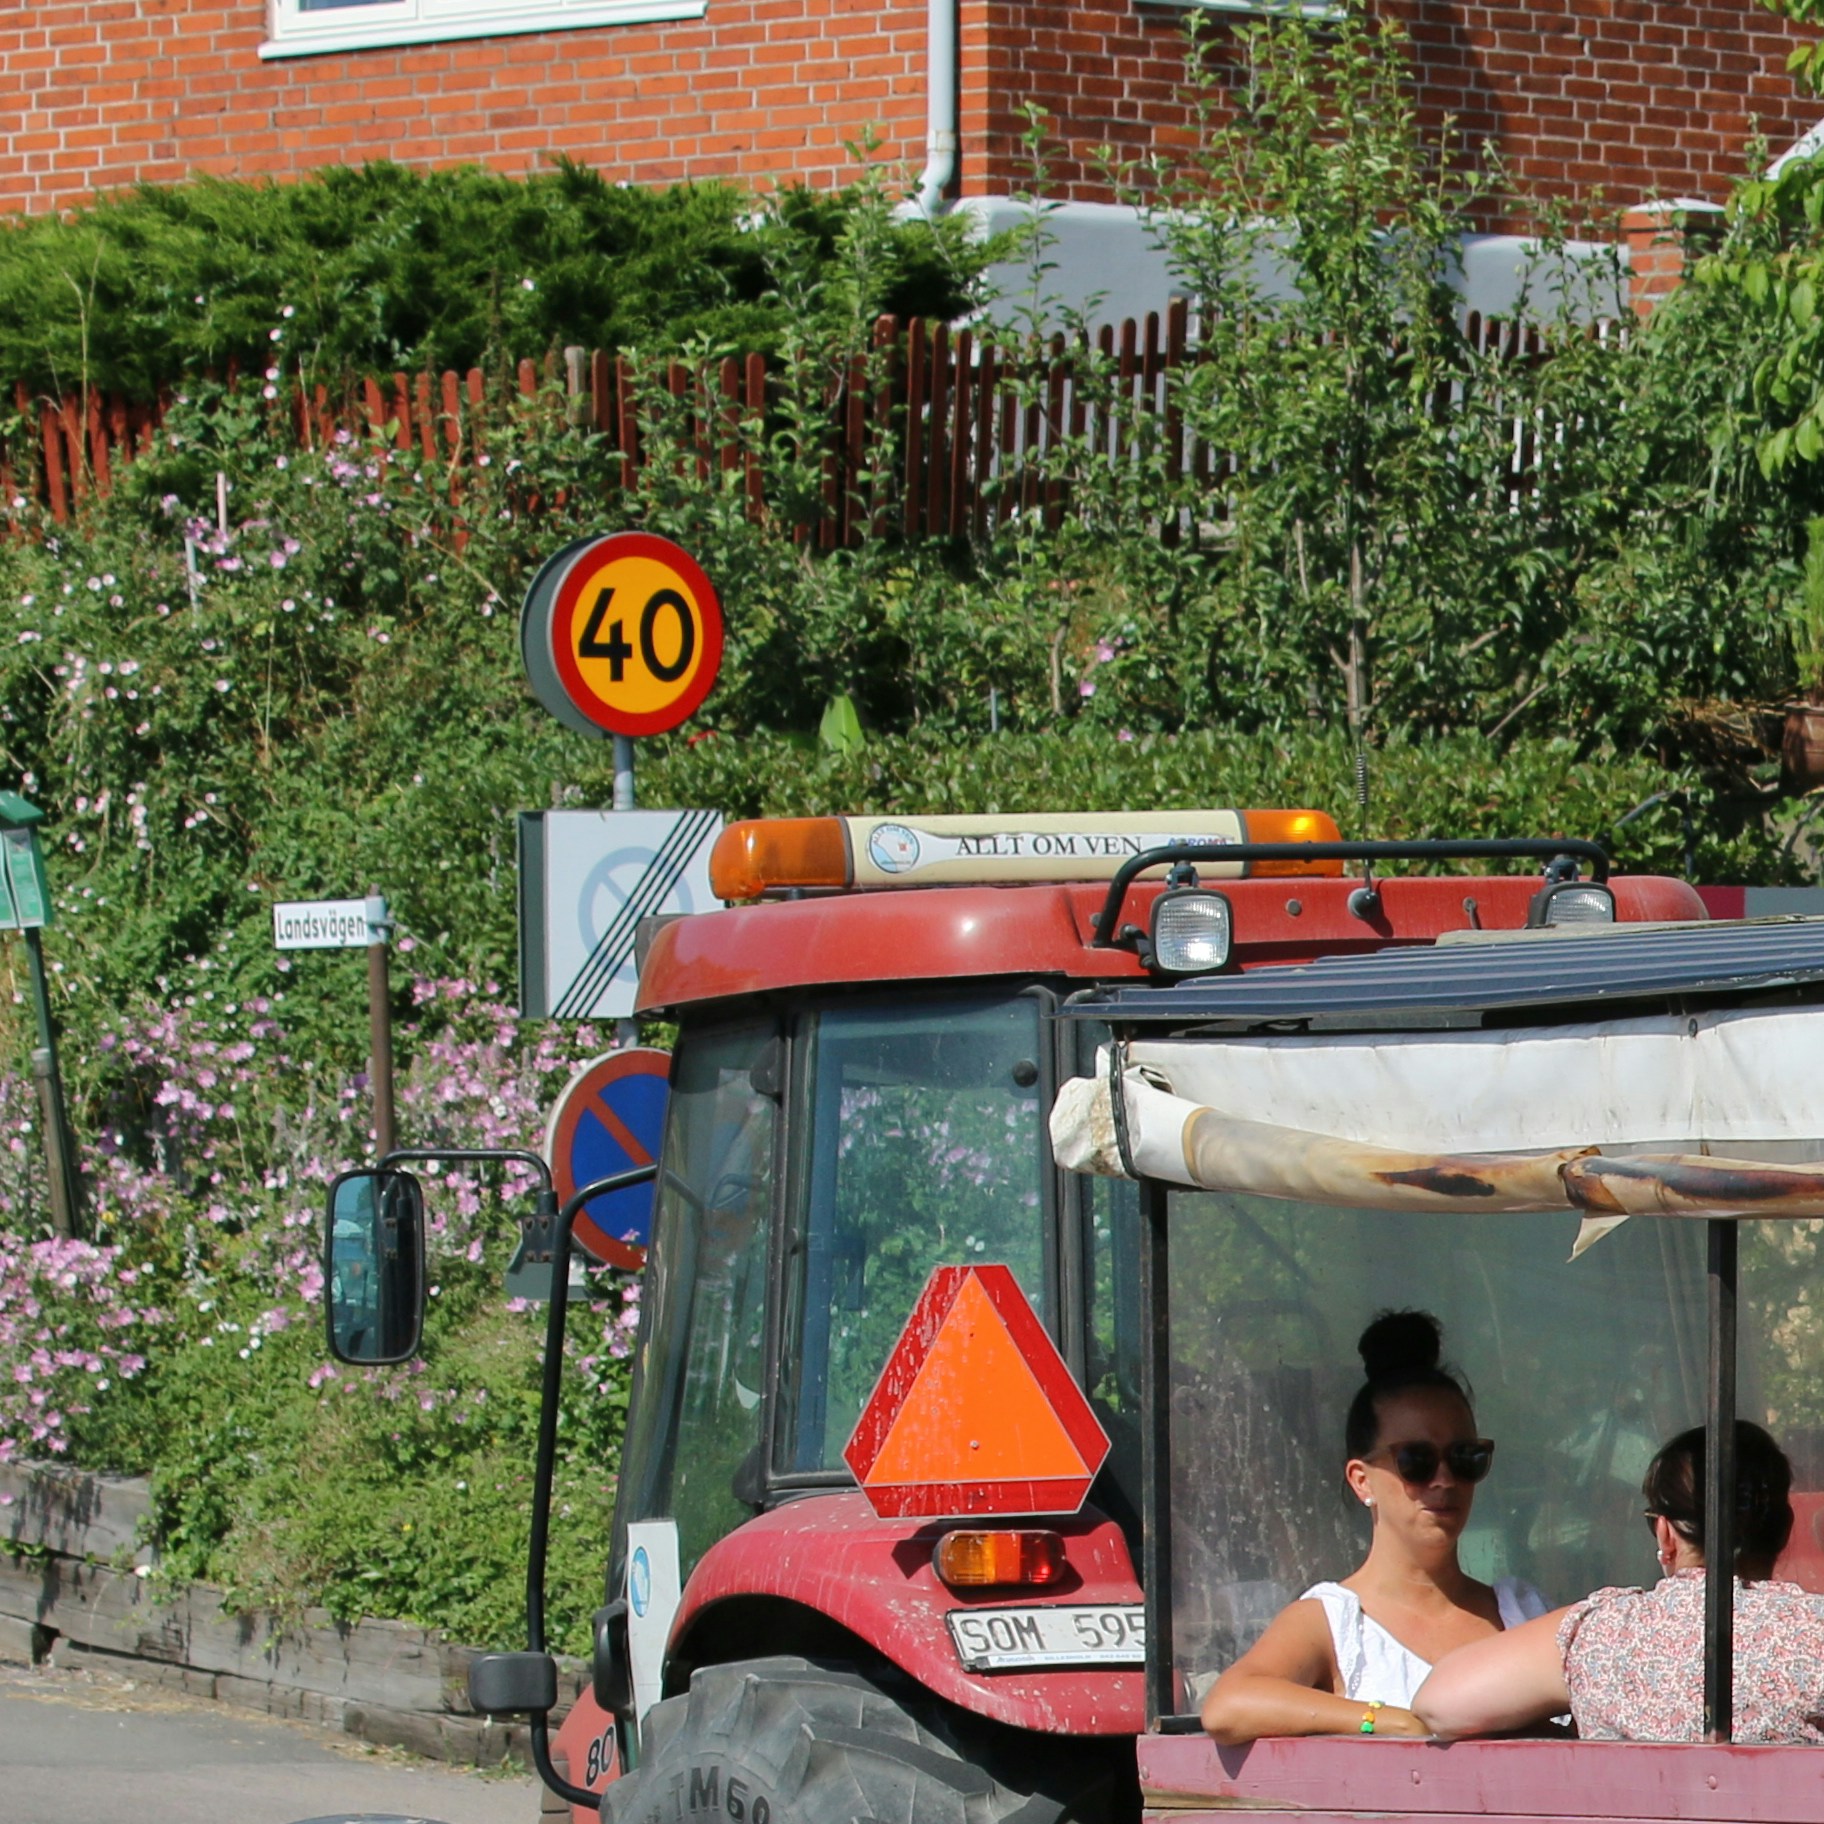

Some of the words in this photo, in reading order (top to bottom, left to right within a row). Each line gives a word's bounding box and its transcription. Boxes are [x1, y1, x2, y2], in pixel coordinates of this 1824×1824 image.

[578, 587, 695, 683] 40
[956, 836, 1025, 856] ALLT
[1032, 836, 1078, 856] OM
[1083, 835, 1143, 856] VEN
[277, 909, 365, 945] Landsvägen
[959, 1614, 1046, 1654] SOM
[1073, 1611, 1146, 1649] 595
